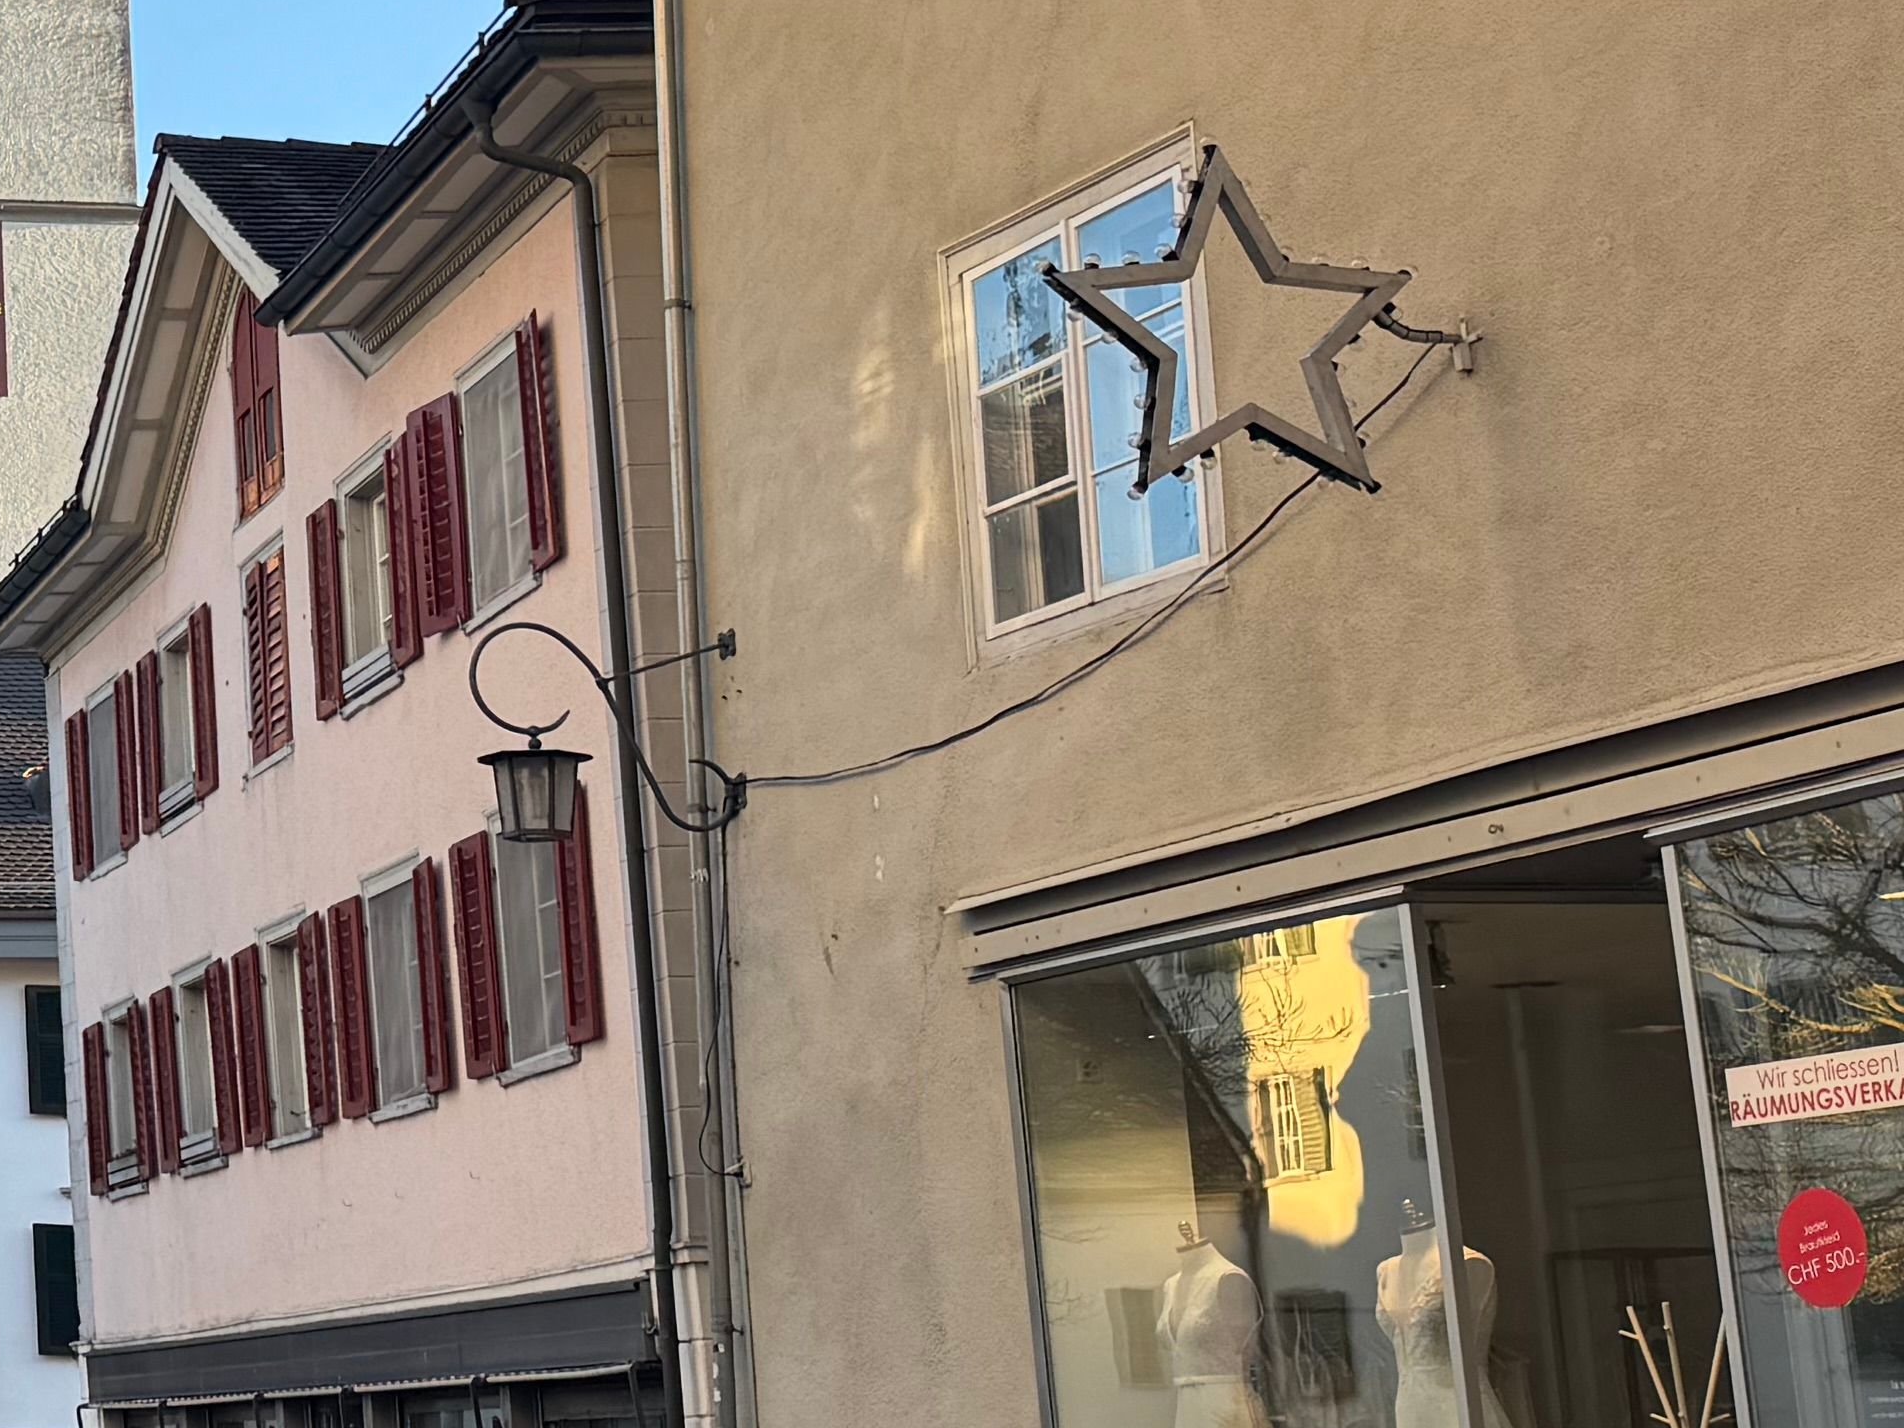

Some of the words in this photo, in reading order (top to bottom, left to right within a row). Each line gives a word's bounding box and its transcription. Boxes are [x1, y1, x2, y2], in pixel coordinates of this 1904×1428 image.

[1756, 1067, 1786, 1090] Wir
[1793, 1049, 1900, 1086] schliessen!
[1787, 1257, 1822, 1285] CHF
[1825, 1247, 1865, 1273] 500.-
